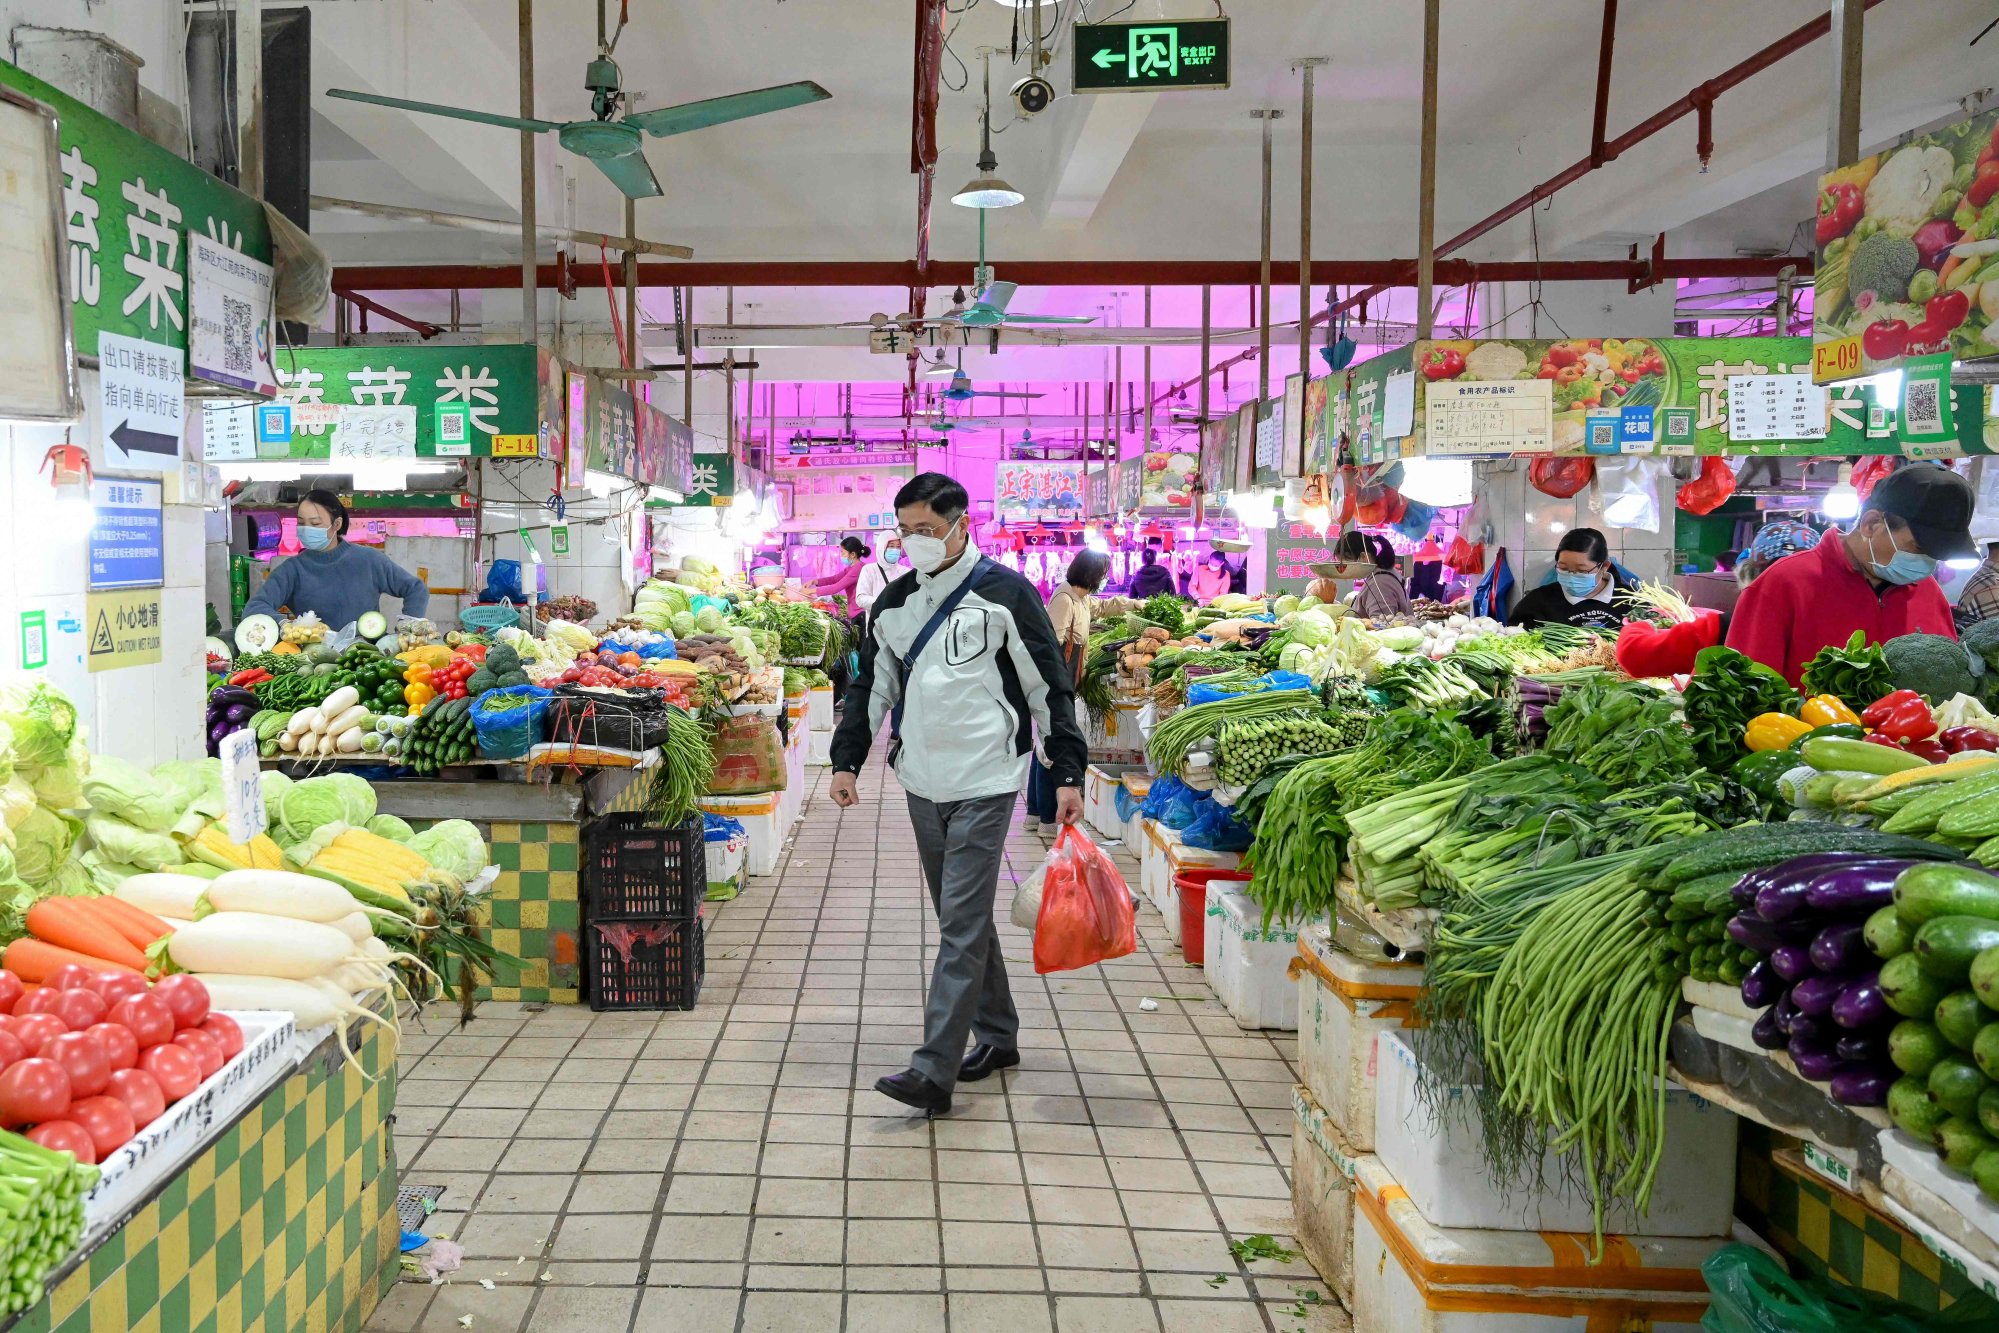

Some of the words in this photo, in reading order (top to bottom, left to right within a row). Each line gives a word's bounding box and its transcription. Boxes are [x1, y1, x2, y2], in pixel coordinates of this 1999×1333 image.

[1181, 45, 1216, 58] 安全出口
[1184, 57, 1212, 66] EXIT
[104, 343, 181, 383] 出口请按箭头
[1816, 342, 1859, 376] F-09
[1458, 386, 1515, 396] 食用农产品标识
[105, 380, 179, 419] 指向单向行走
[1624, 422, 1650, 434] 花呗
[494, 437, 534, 454] F-14
[1276, 548, 1337, 562] 宁愿买少
[116, 602, 158, 630] 小心地滑
[147, 636, 160, 648] FLOOR
